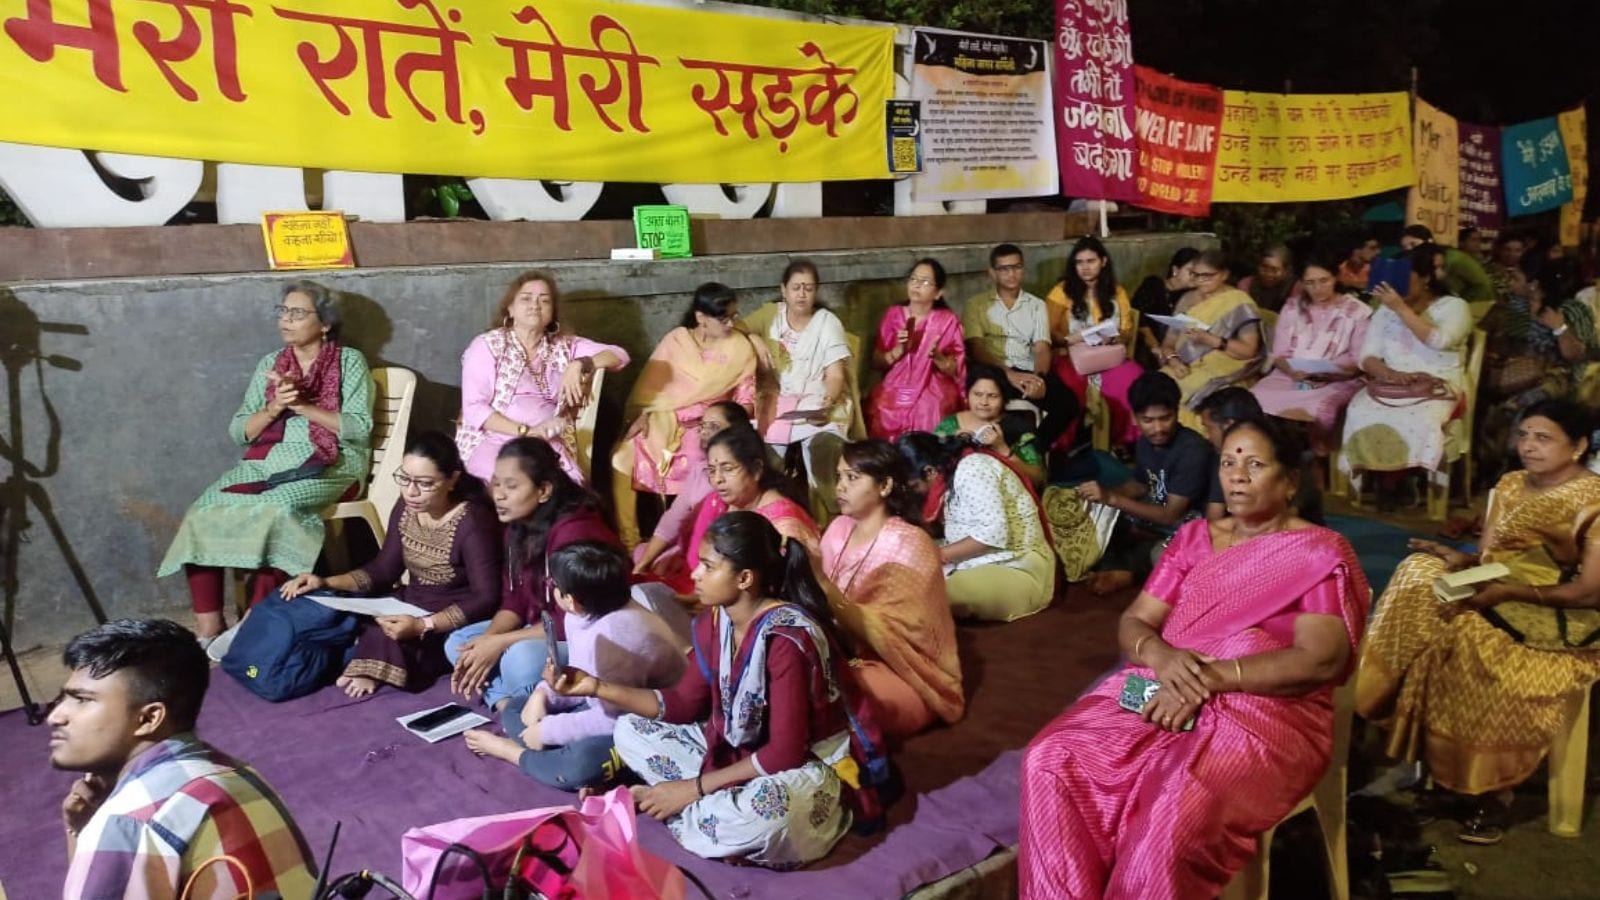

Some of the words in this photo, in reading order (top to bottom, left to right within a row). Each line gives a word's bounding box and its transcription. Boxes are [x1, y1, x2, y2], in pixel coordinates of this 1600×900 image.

[493, 5, 660, 133] मेरी
[1167, 120, 1185, 149] OF
[641, 231, 665, 249] STOP
